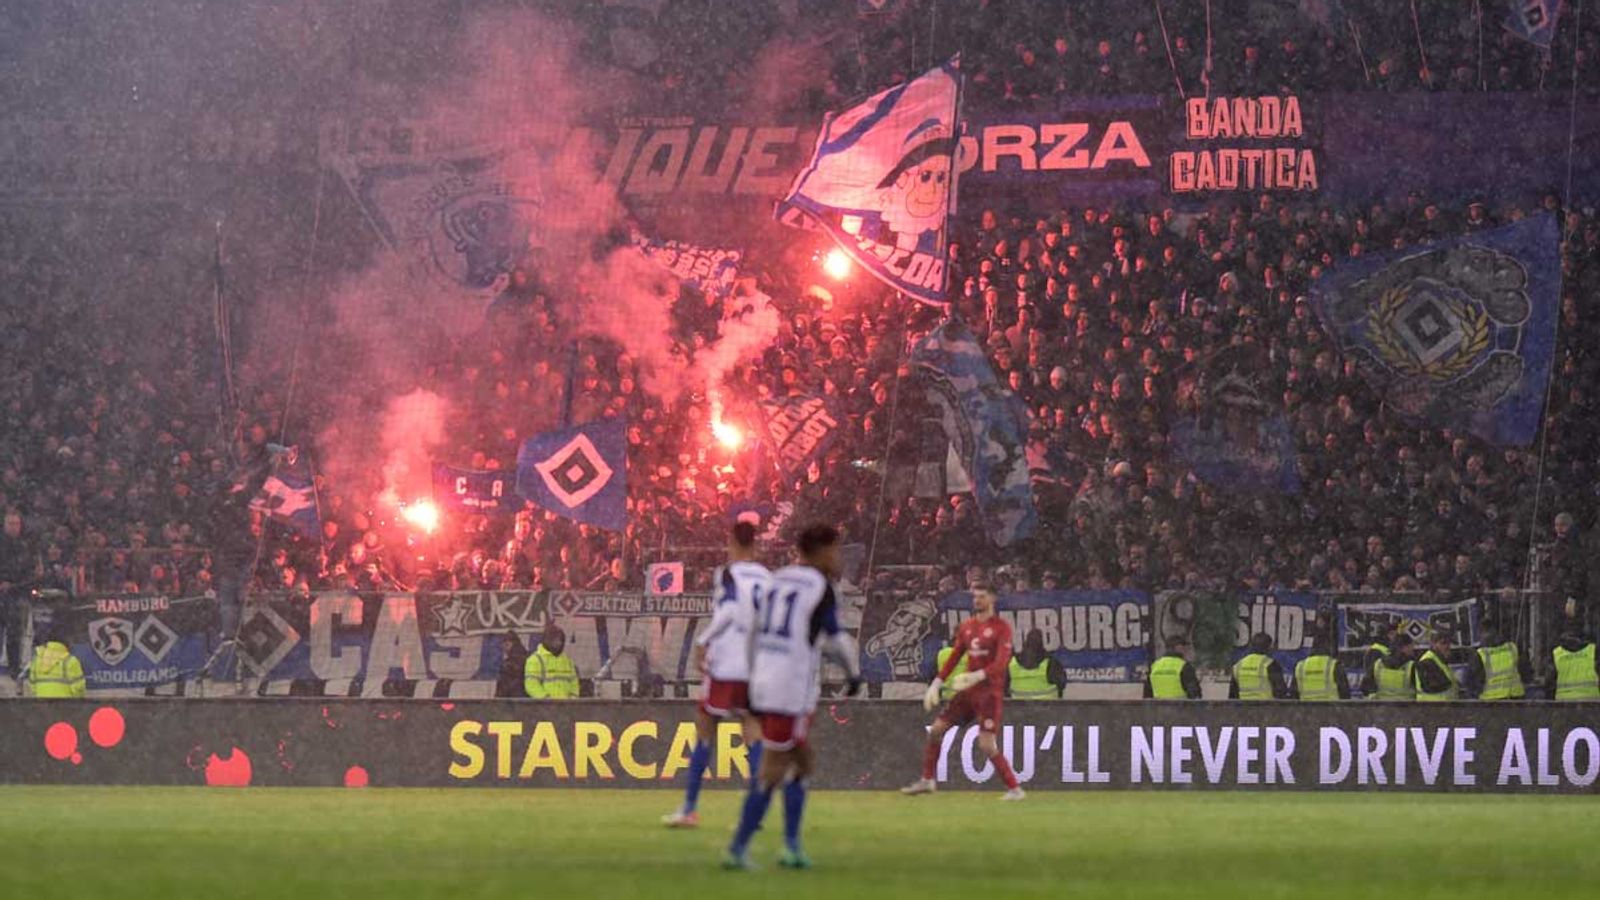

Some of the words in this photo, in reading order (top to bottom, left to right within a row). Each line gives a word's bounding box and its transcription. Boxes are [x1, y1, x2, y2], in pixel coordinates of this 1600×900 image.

[1186, 95, 1302, 139] BANDA
[1170, 148, 1318, 193] CAOTICA
[96, 596, 169, 613] HAMBURG
[448, 720, 750, 779] STARCAR
[1130, 726, 1295, 784] NEVER
[1319, 727, 1476, 785] DRIVE
[1496, 728, 1600, 786] ALO
